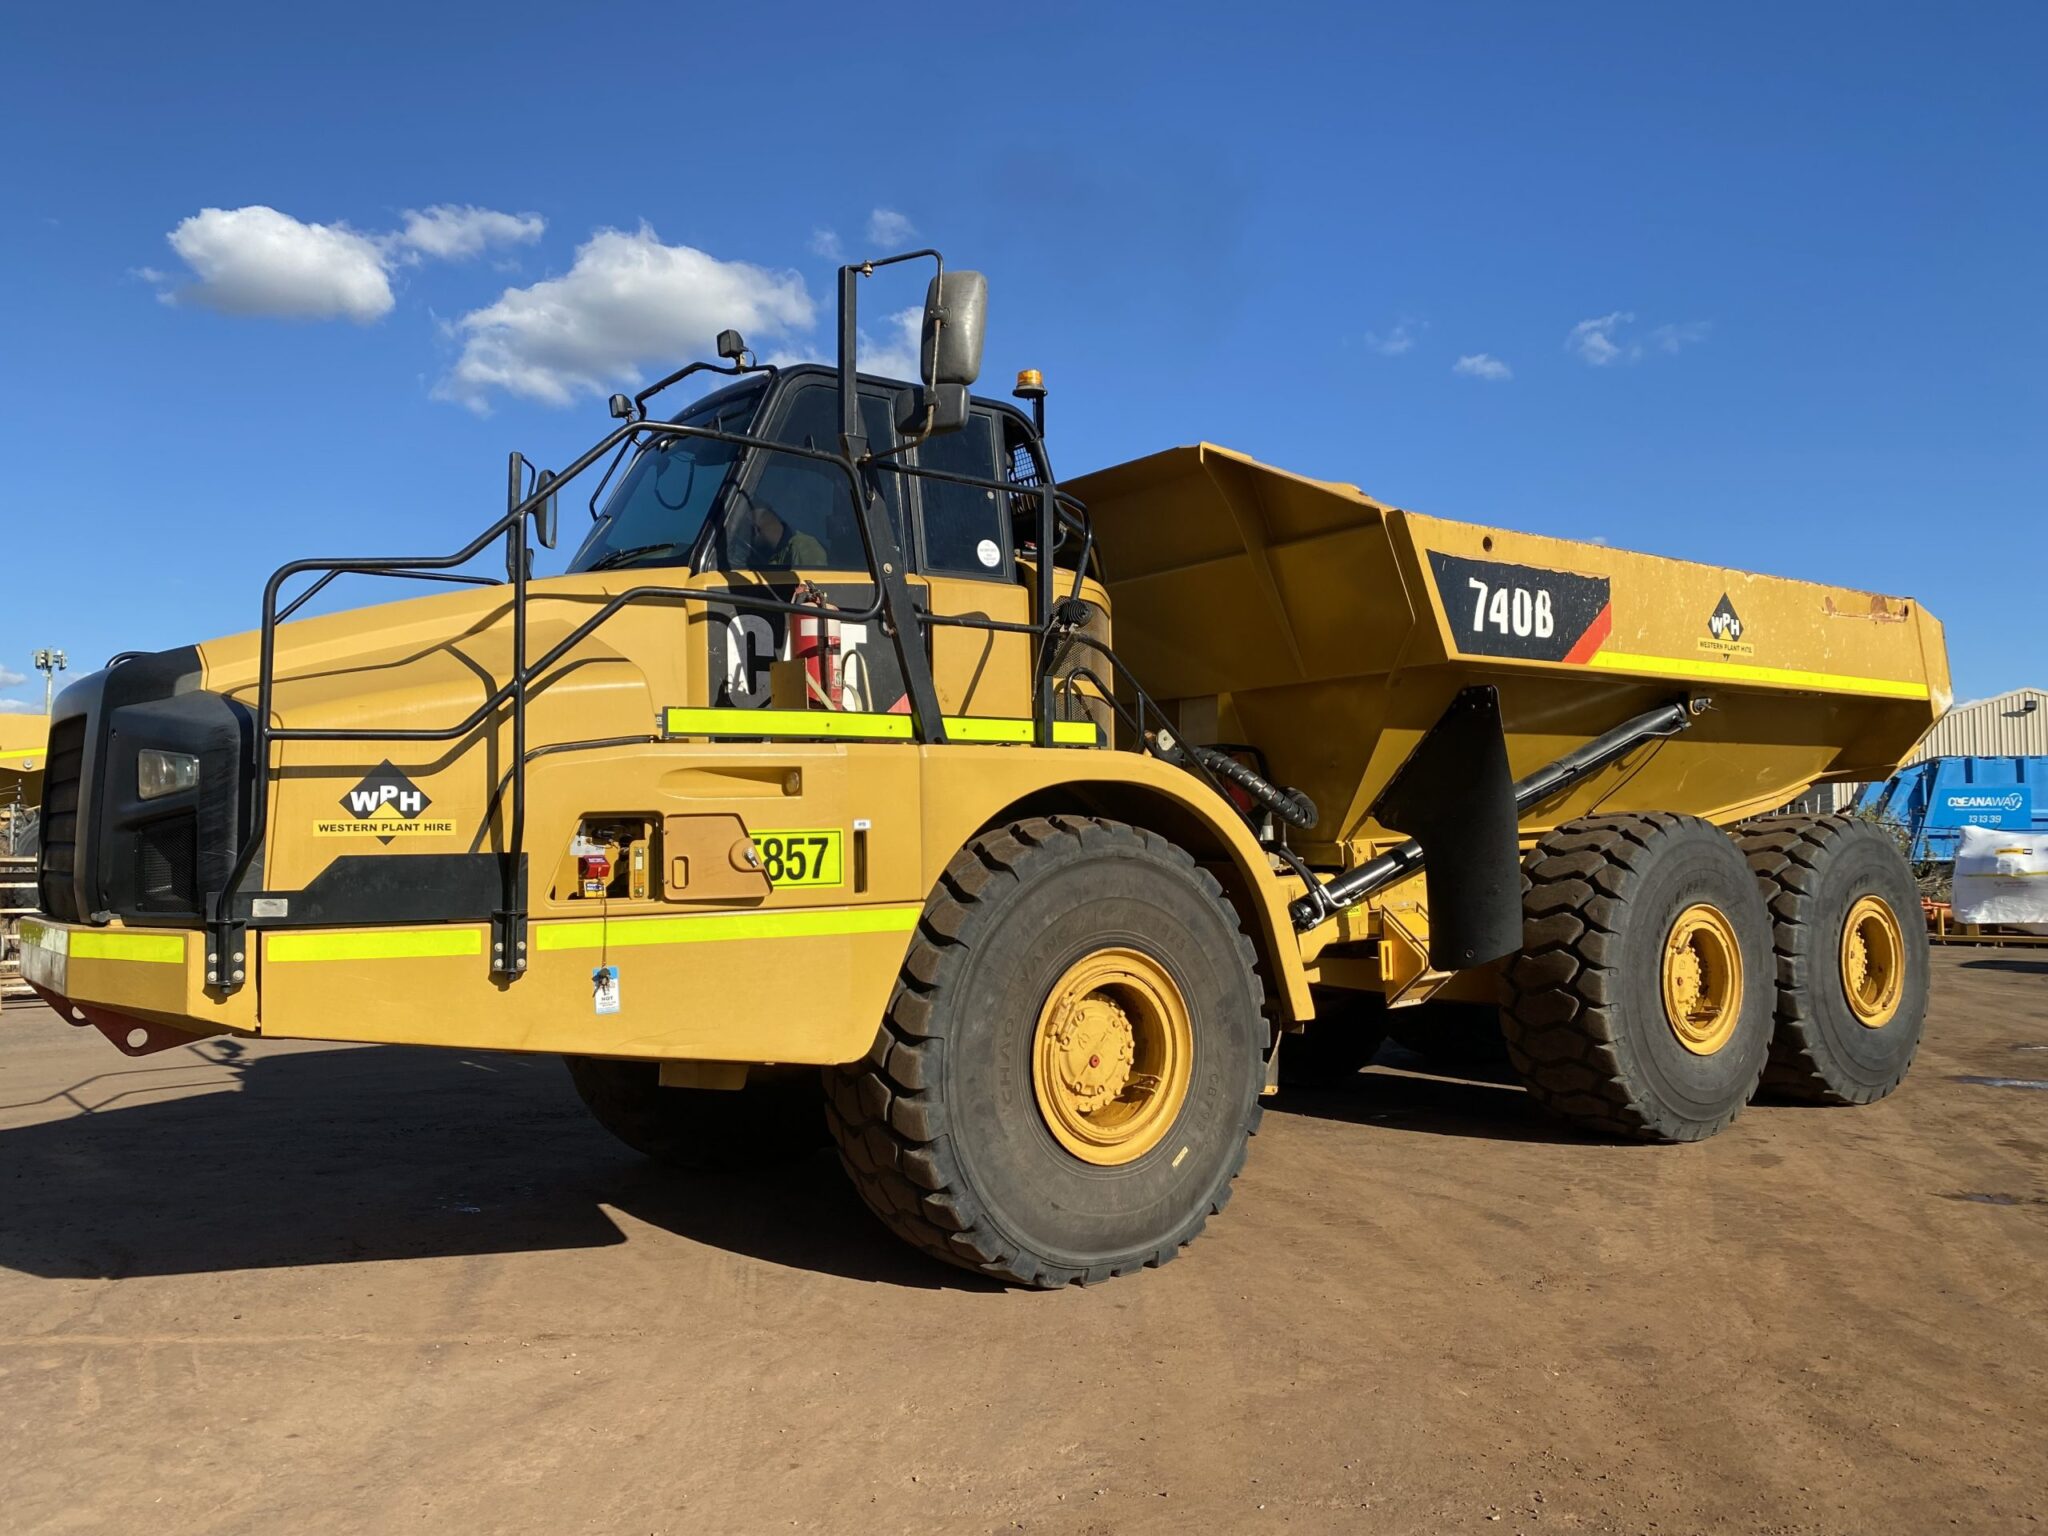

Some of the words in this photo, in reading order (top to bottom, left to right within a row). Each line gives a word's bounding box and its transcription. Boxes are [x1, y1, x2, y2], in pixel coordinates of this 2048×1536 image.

[1469, 577, 1554, 638] 740B
[1711, 613, 1739, 636] WPH
[1700, 641, 1723, 650] WESTERN
[1724, 643, 1740, 652] PLANT
[727, 614, 867, 711] CT
[350, 785, 421, 811] WPH
[1948, 796, 2019, 807] CLEANAWAY
[319, 824, 377, 832] WESTERN
[382, 823, 420, 832] PLANT
[424, 823, 452, 831] HIRE
[752, 837, 829, 881] 857
